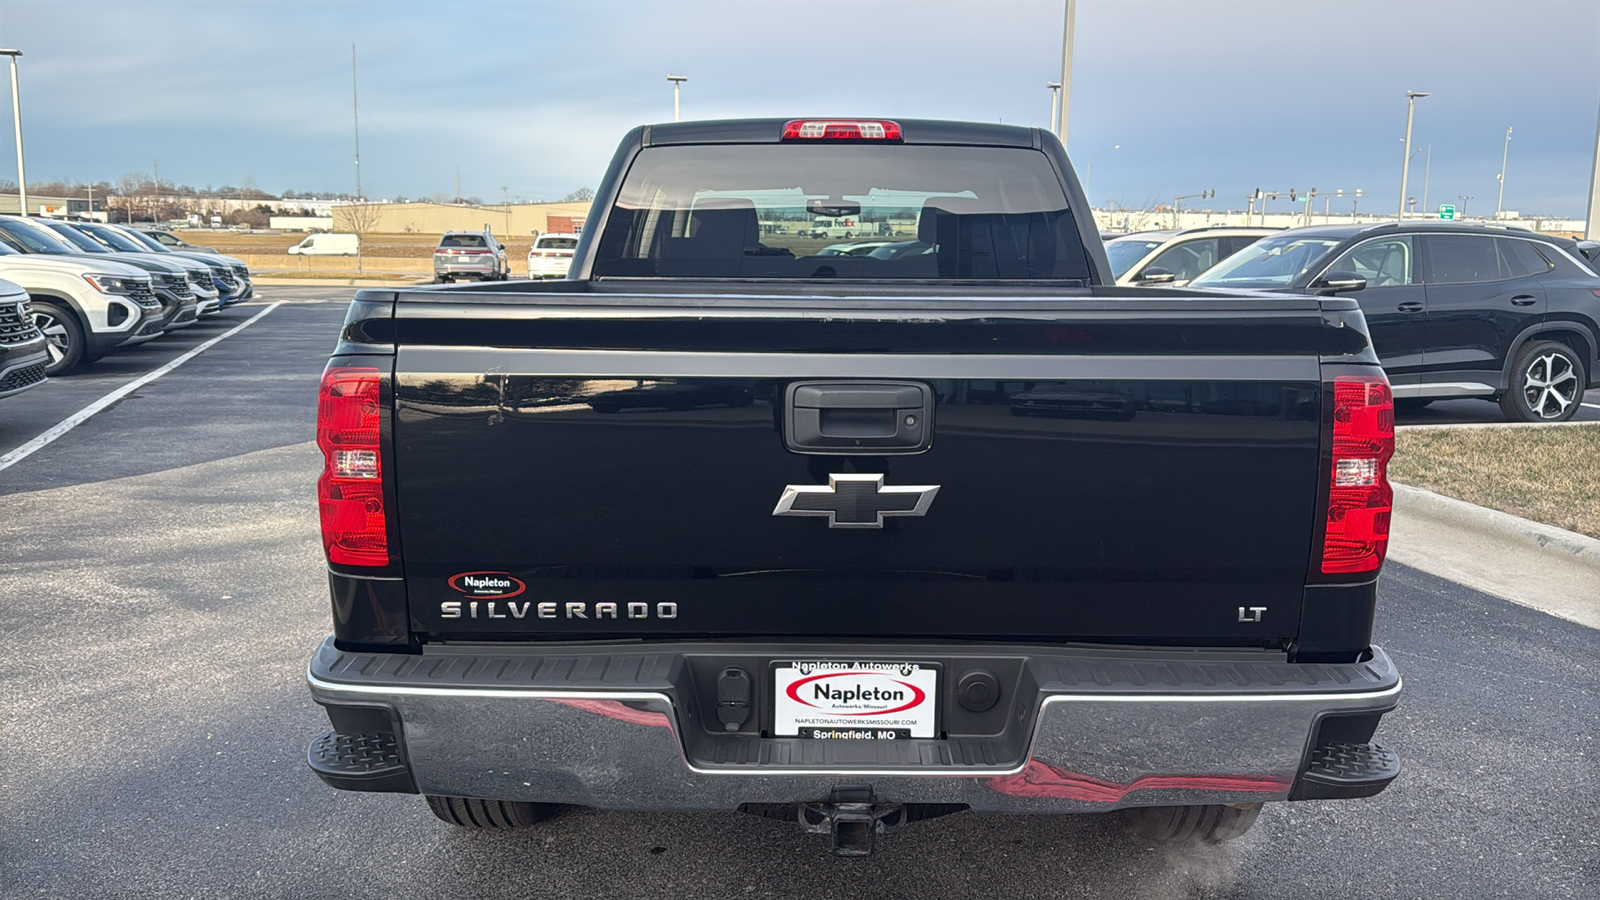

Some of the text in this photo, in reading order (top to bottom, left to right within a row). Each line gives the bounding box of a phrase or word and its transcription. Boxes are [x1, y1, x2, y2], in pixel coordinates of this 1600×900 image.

[834, 218, 855, 228] FedEx
[464, 576, 510, 589] Napleton
[441, 602, 678, 619] SILVERADO
[1238, 606, 1267, 622] LT
[792, 661, 920, 672] Napleton Autowerks
[814, 683, 904, 704] Napleton
[795, 718, 917, 726] NAPLETONAUTOWERKSMISSOURI.COM
[877, 730, 896, 740] MO
